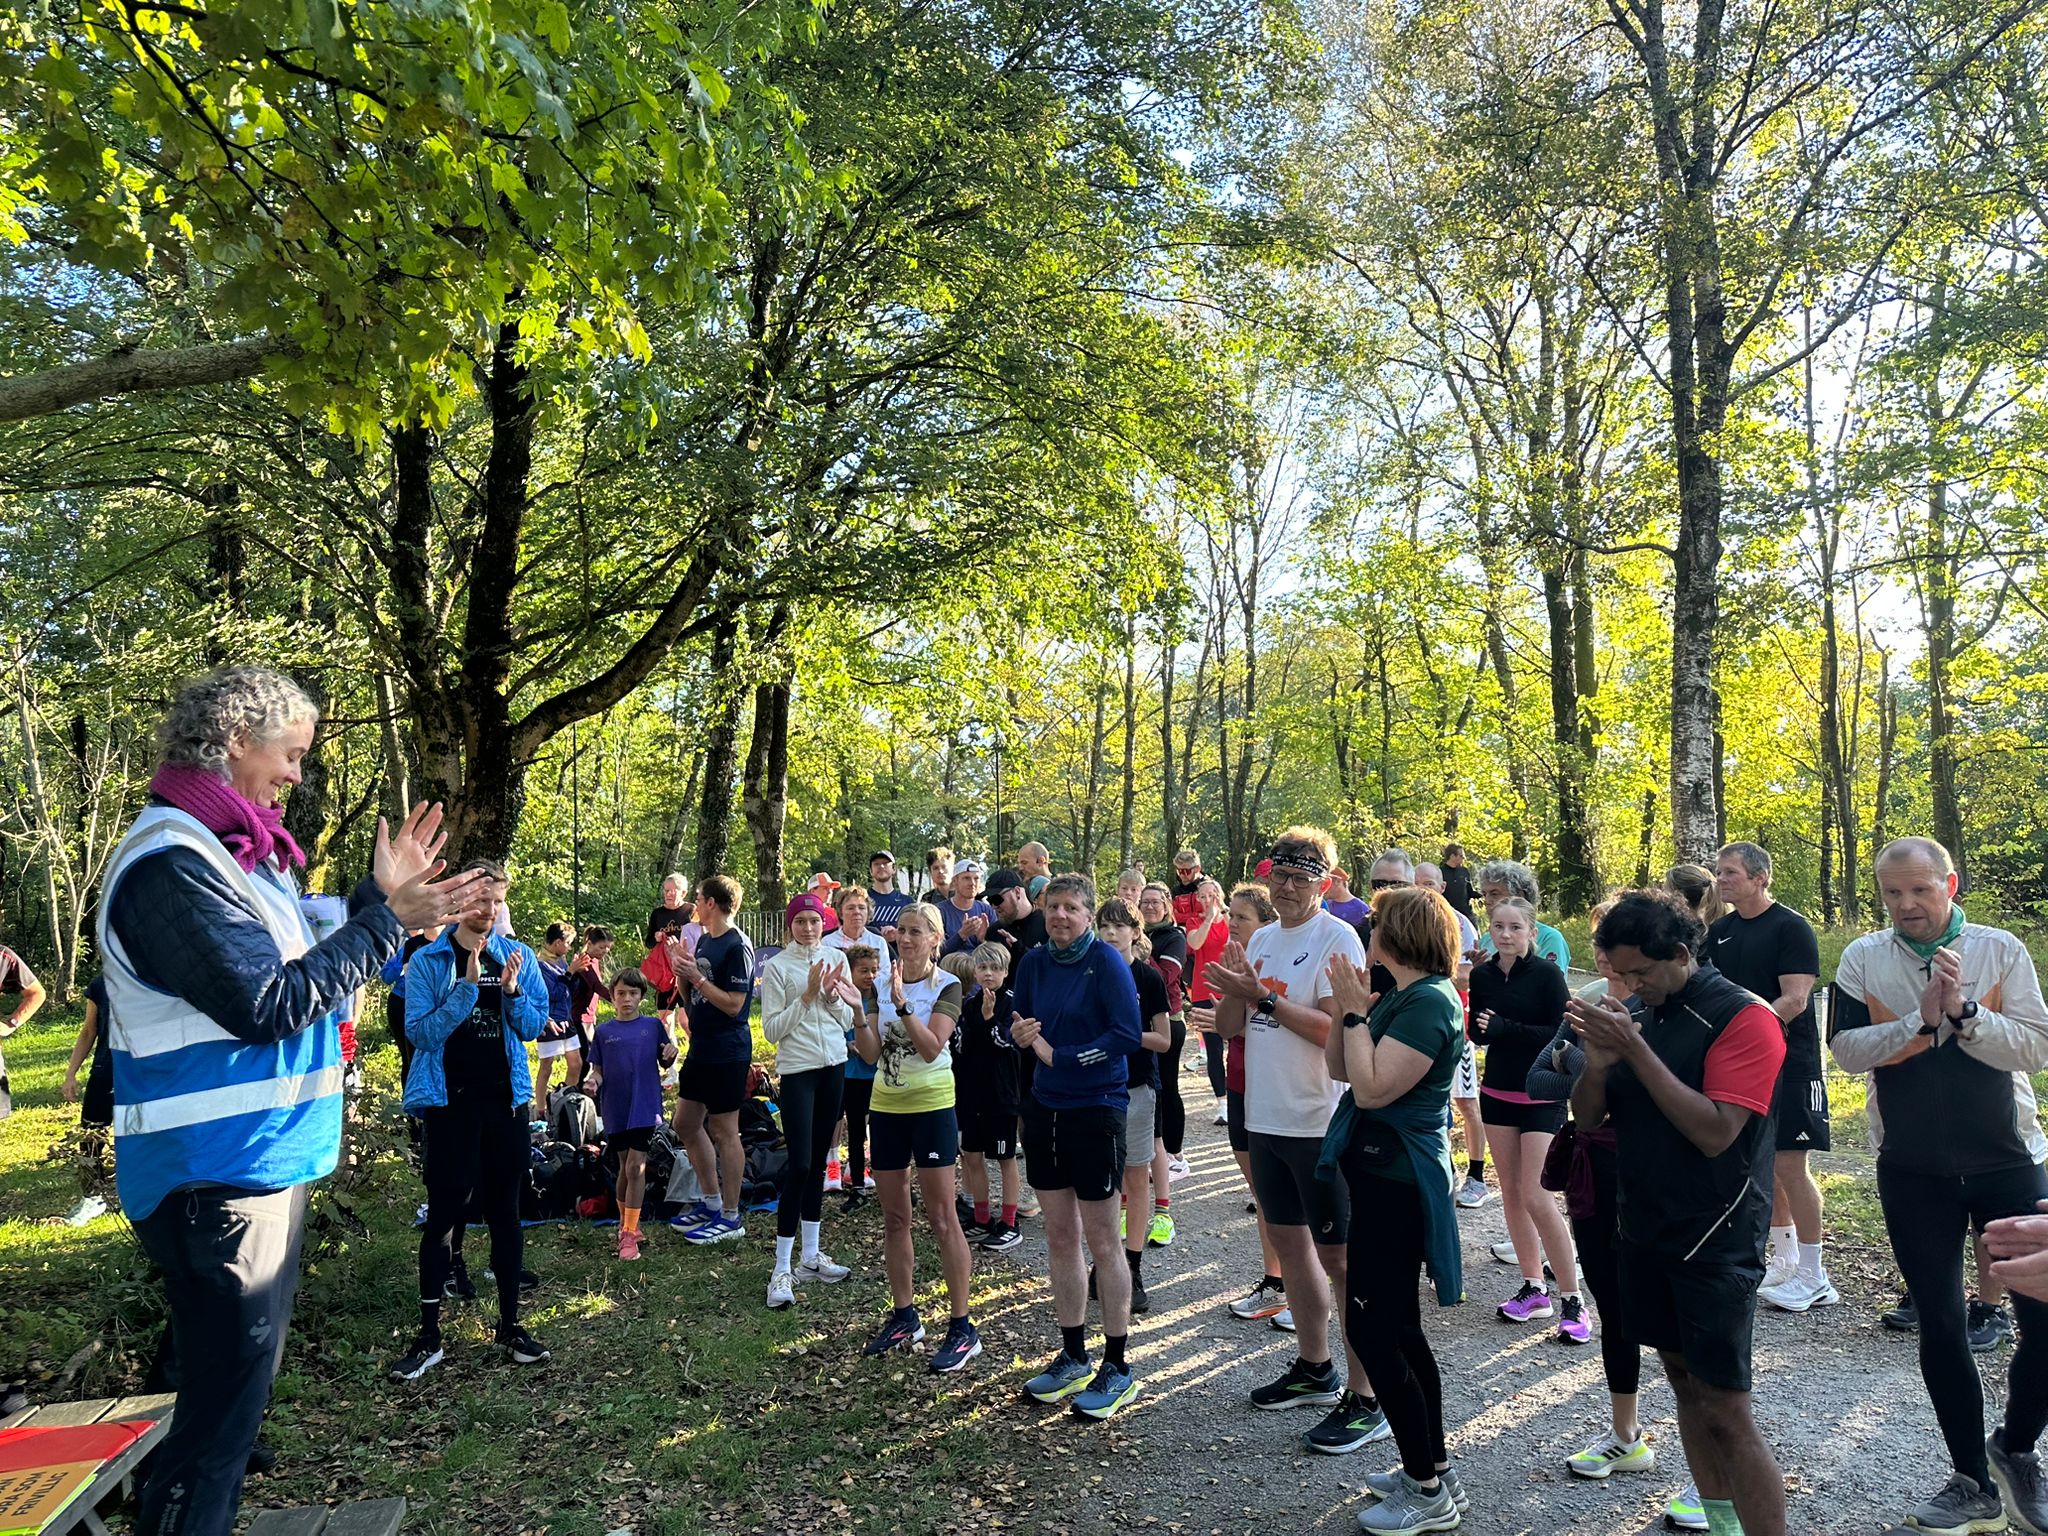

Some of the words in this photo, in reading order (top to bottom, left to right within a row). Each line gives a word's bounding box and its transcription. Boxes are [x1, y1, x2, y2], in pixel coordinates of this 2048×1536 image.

[997, 1140, 1006, 1155] 10
[1247, 1294, 1279, 1309] BROOKS
[13, 1471, 47, 1492] SOM
[11, 1471, 69, 1516] FRIVILLIG
